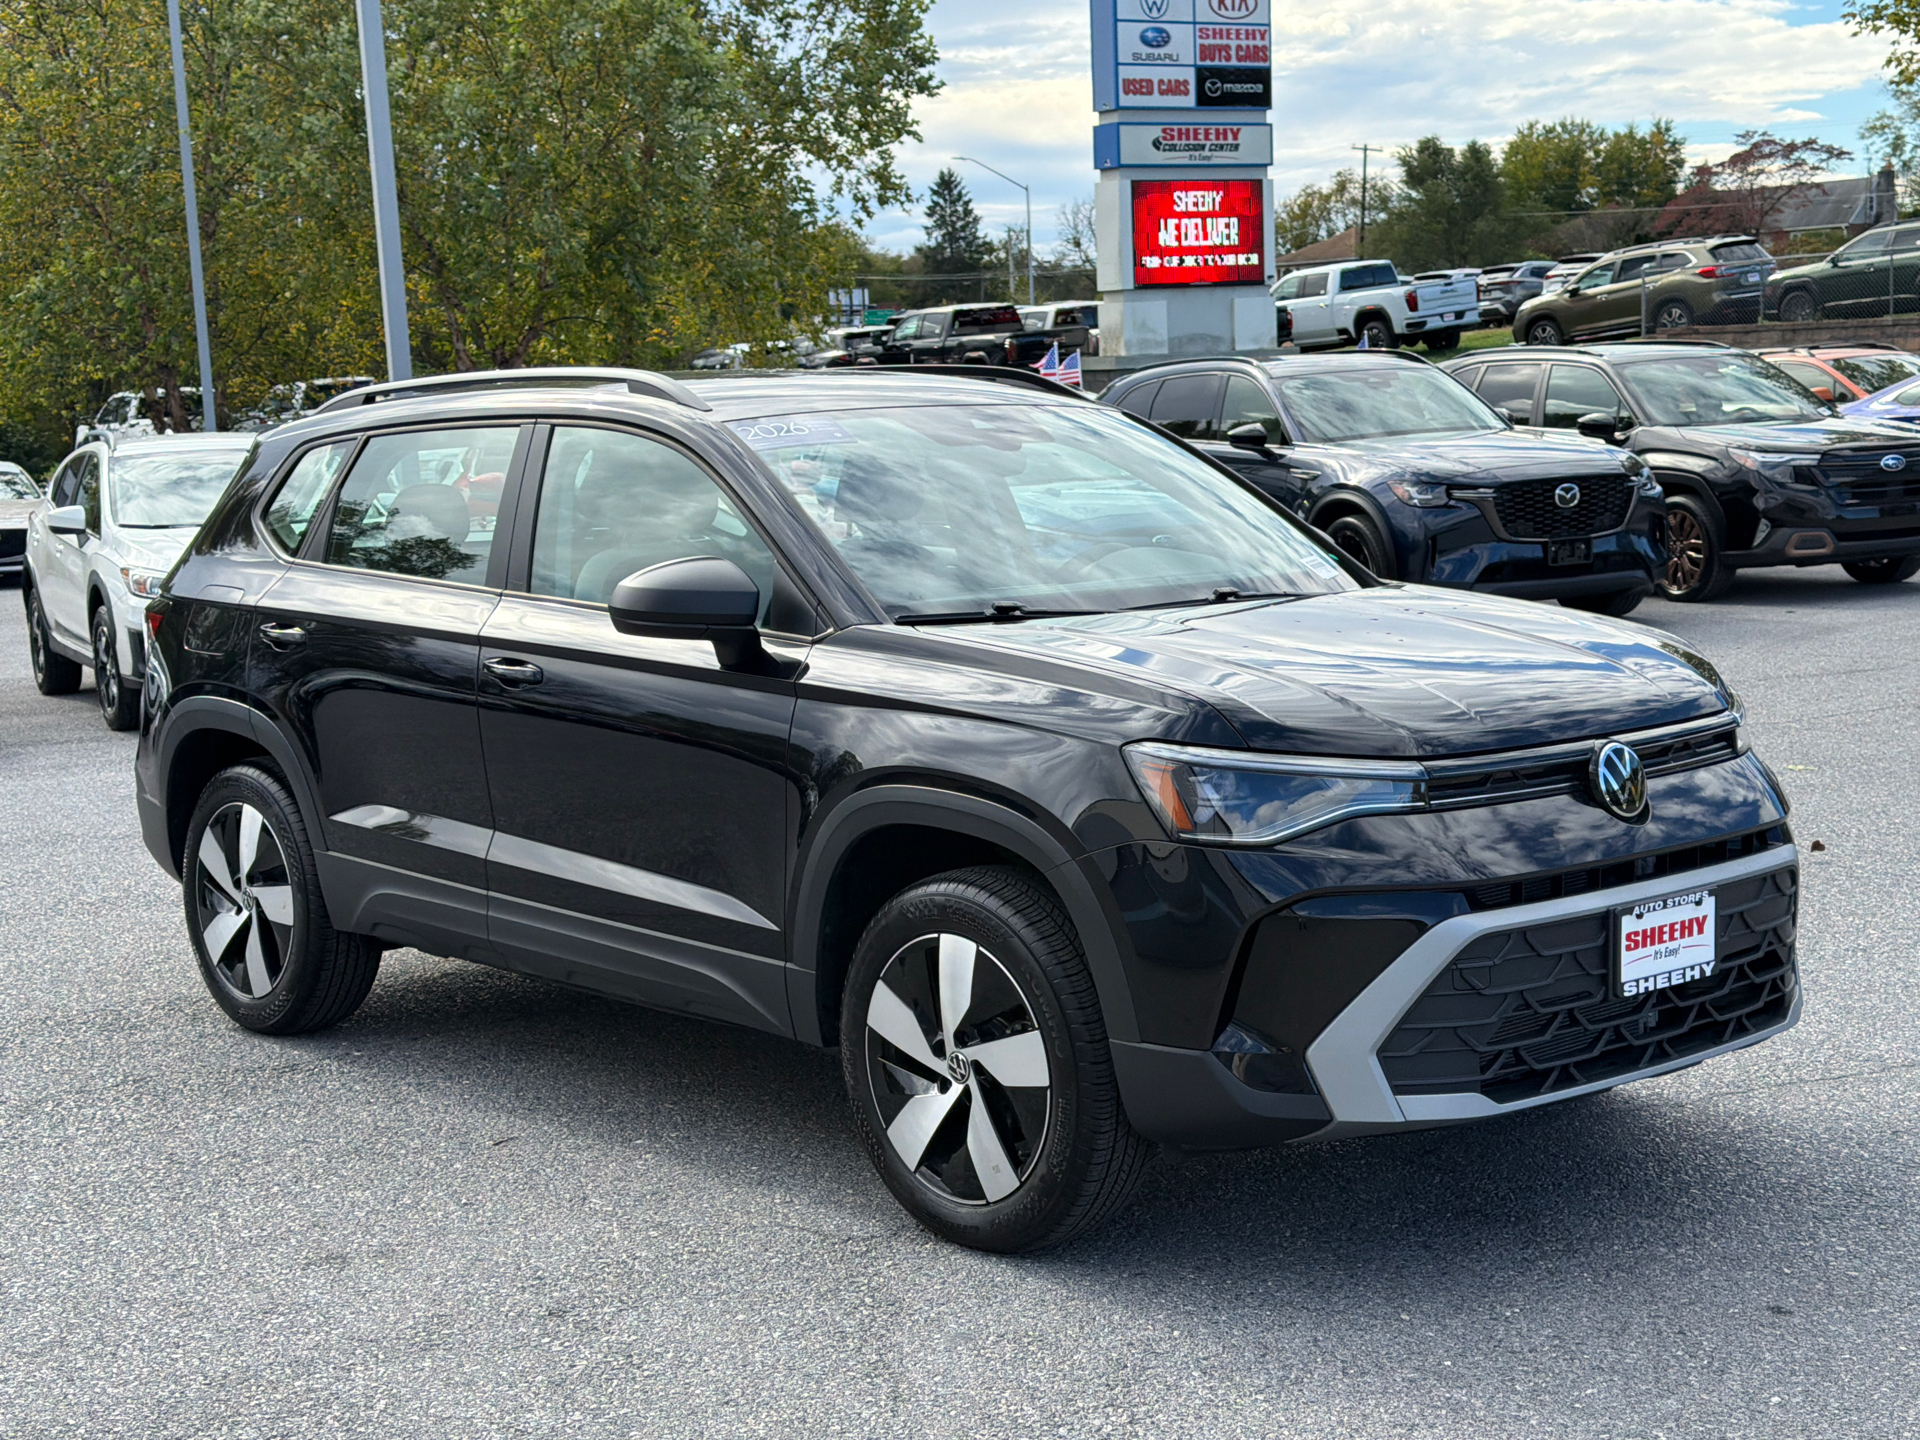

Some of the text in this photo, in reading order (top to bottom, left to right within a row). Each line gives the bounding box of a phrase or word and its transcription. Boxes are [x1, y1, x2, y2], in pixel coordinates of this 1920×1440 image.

[1198, 27, 1268, 41] SHEEHY
[1132, 52, 1179, 62] SUBARU
[1199, 44, 1269, 63] BUYS CARS
[1122, 78, 1190, 96] USED CARS
[1223, 83, 1264, 93] mazda
[1161, 127, 1242, 141] SHEEHY
[1162, 143, 1240, 152] COLLISION CENTER
[1173, 190, 1223, 212] SHEEHY
[736, 422, 810, 440] 2026
[1632, 901, 1664, 915] AUTO
[1625, 914, 1708, 952] SHEEHY
[1653, 943, 1681, 961] It's Easy!
[1623, 961, 1716, 997] SHEEHY
